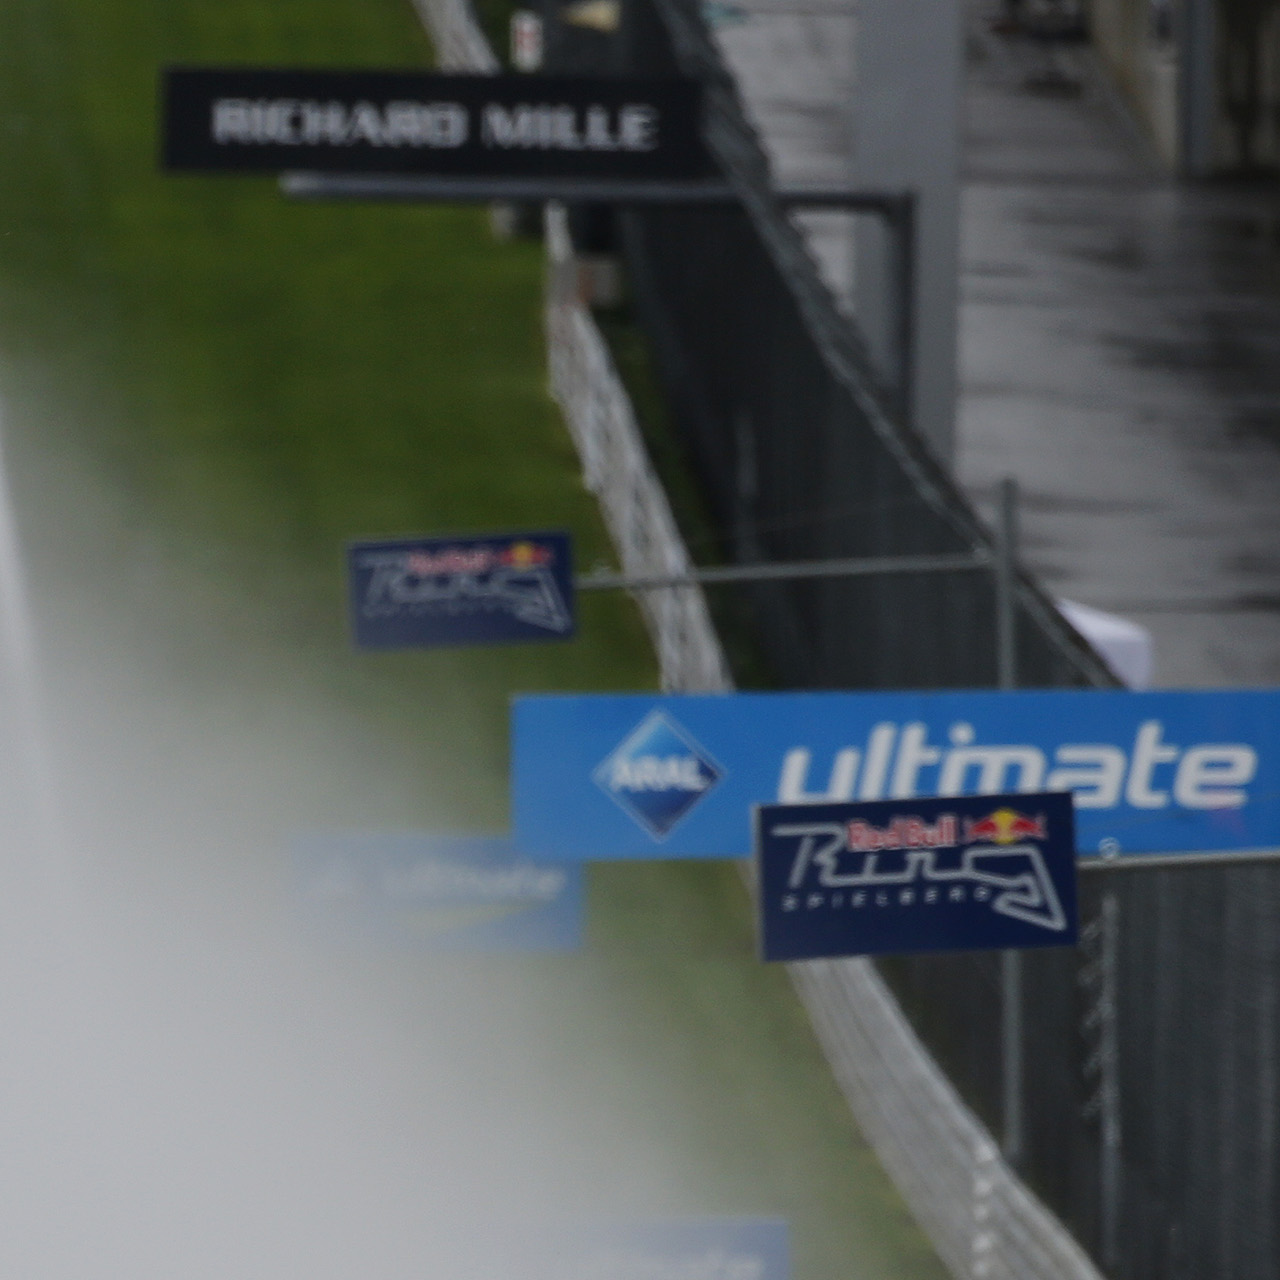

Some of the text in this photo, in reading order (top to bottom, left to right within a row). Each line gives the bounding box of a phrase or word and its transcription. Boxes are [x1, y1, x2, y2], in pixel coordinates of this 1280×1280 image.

[213, 99, 659, 152] RICHARD MILLE
[610, 721, 1258, 808] ARAL ultimate
[848, 816, 957, 850] Red Bull
